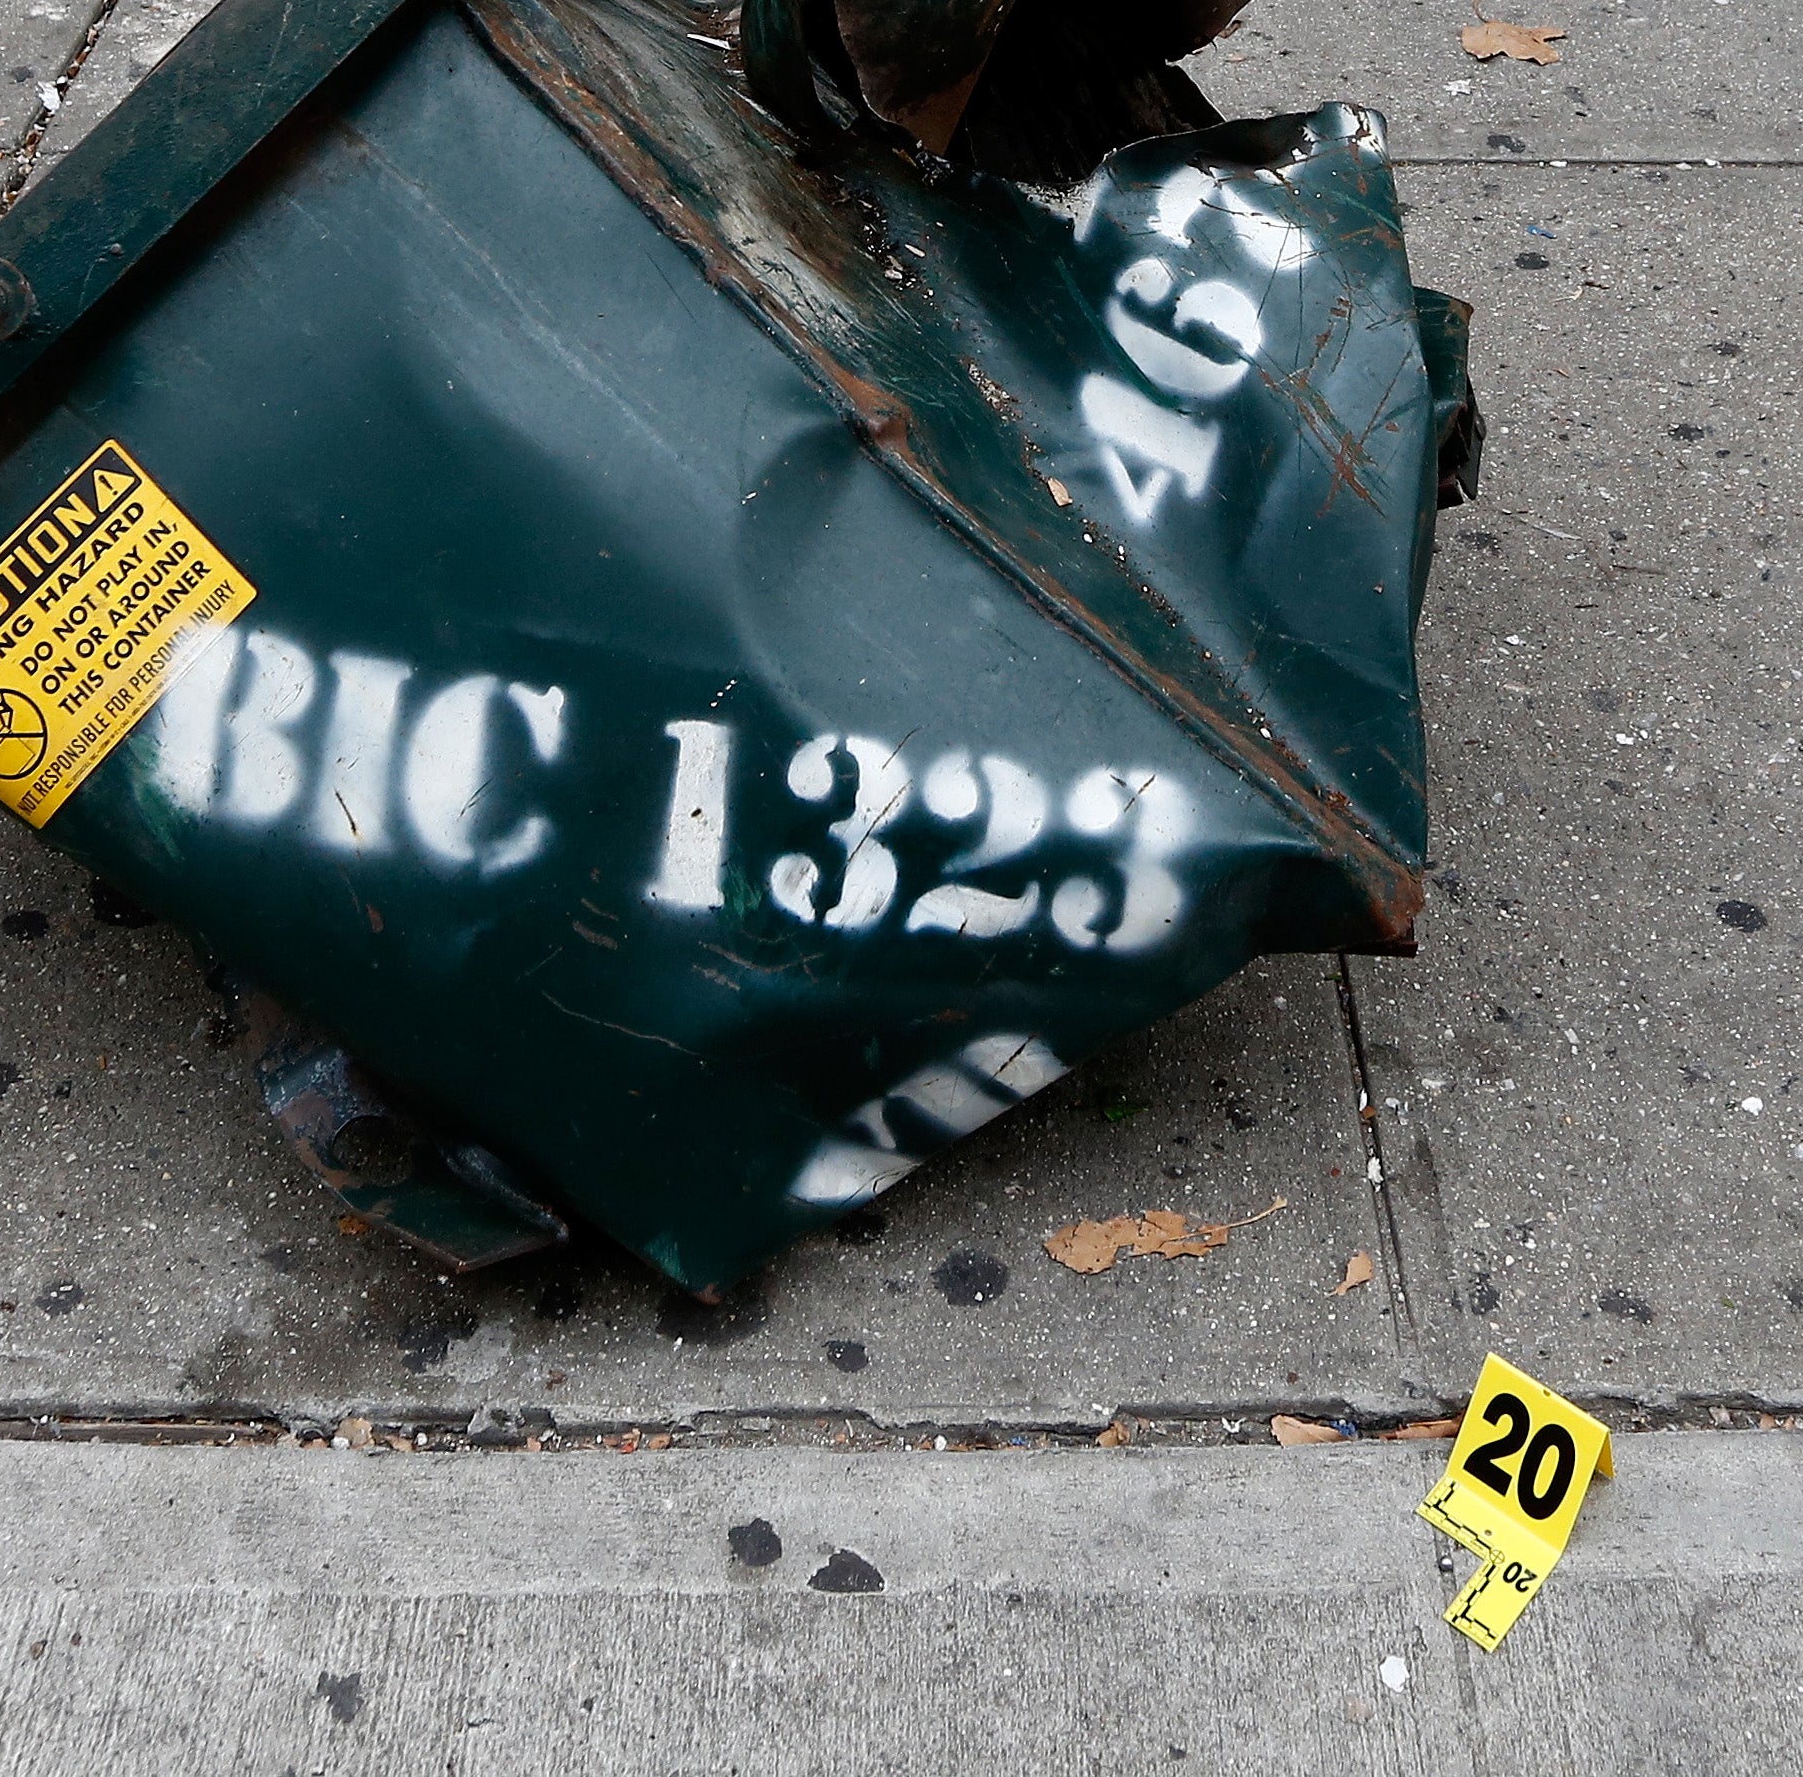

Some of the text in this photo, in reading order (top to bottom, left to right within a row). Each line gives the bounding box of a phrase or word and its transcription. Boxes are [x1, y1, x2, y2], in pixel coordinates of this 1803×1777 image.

[20, 519, 179, 677] DO NOT PLAY IN,
[34, 501, 144, 614] HAZARD
[41, 540, 190, 695] ON OR AROUND
[18, 579, 236, 816] NOT RESPONSIBLE FOR PERSONAL INJURY
[57, 668, 105, 717] THIS
[102, 559, 212, 671] CONTAINER
[147, 626, 567, 875] BIC
[645, 717, 1197, 957] 1323
[1462, 1392, 1577, 1521] 20
[1503, 1561, 1538, 1593] 20
